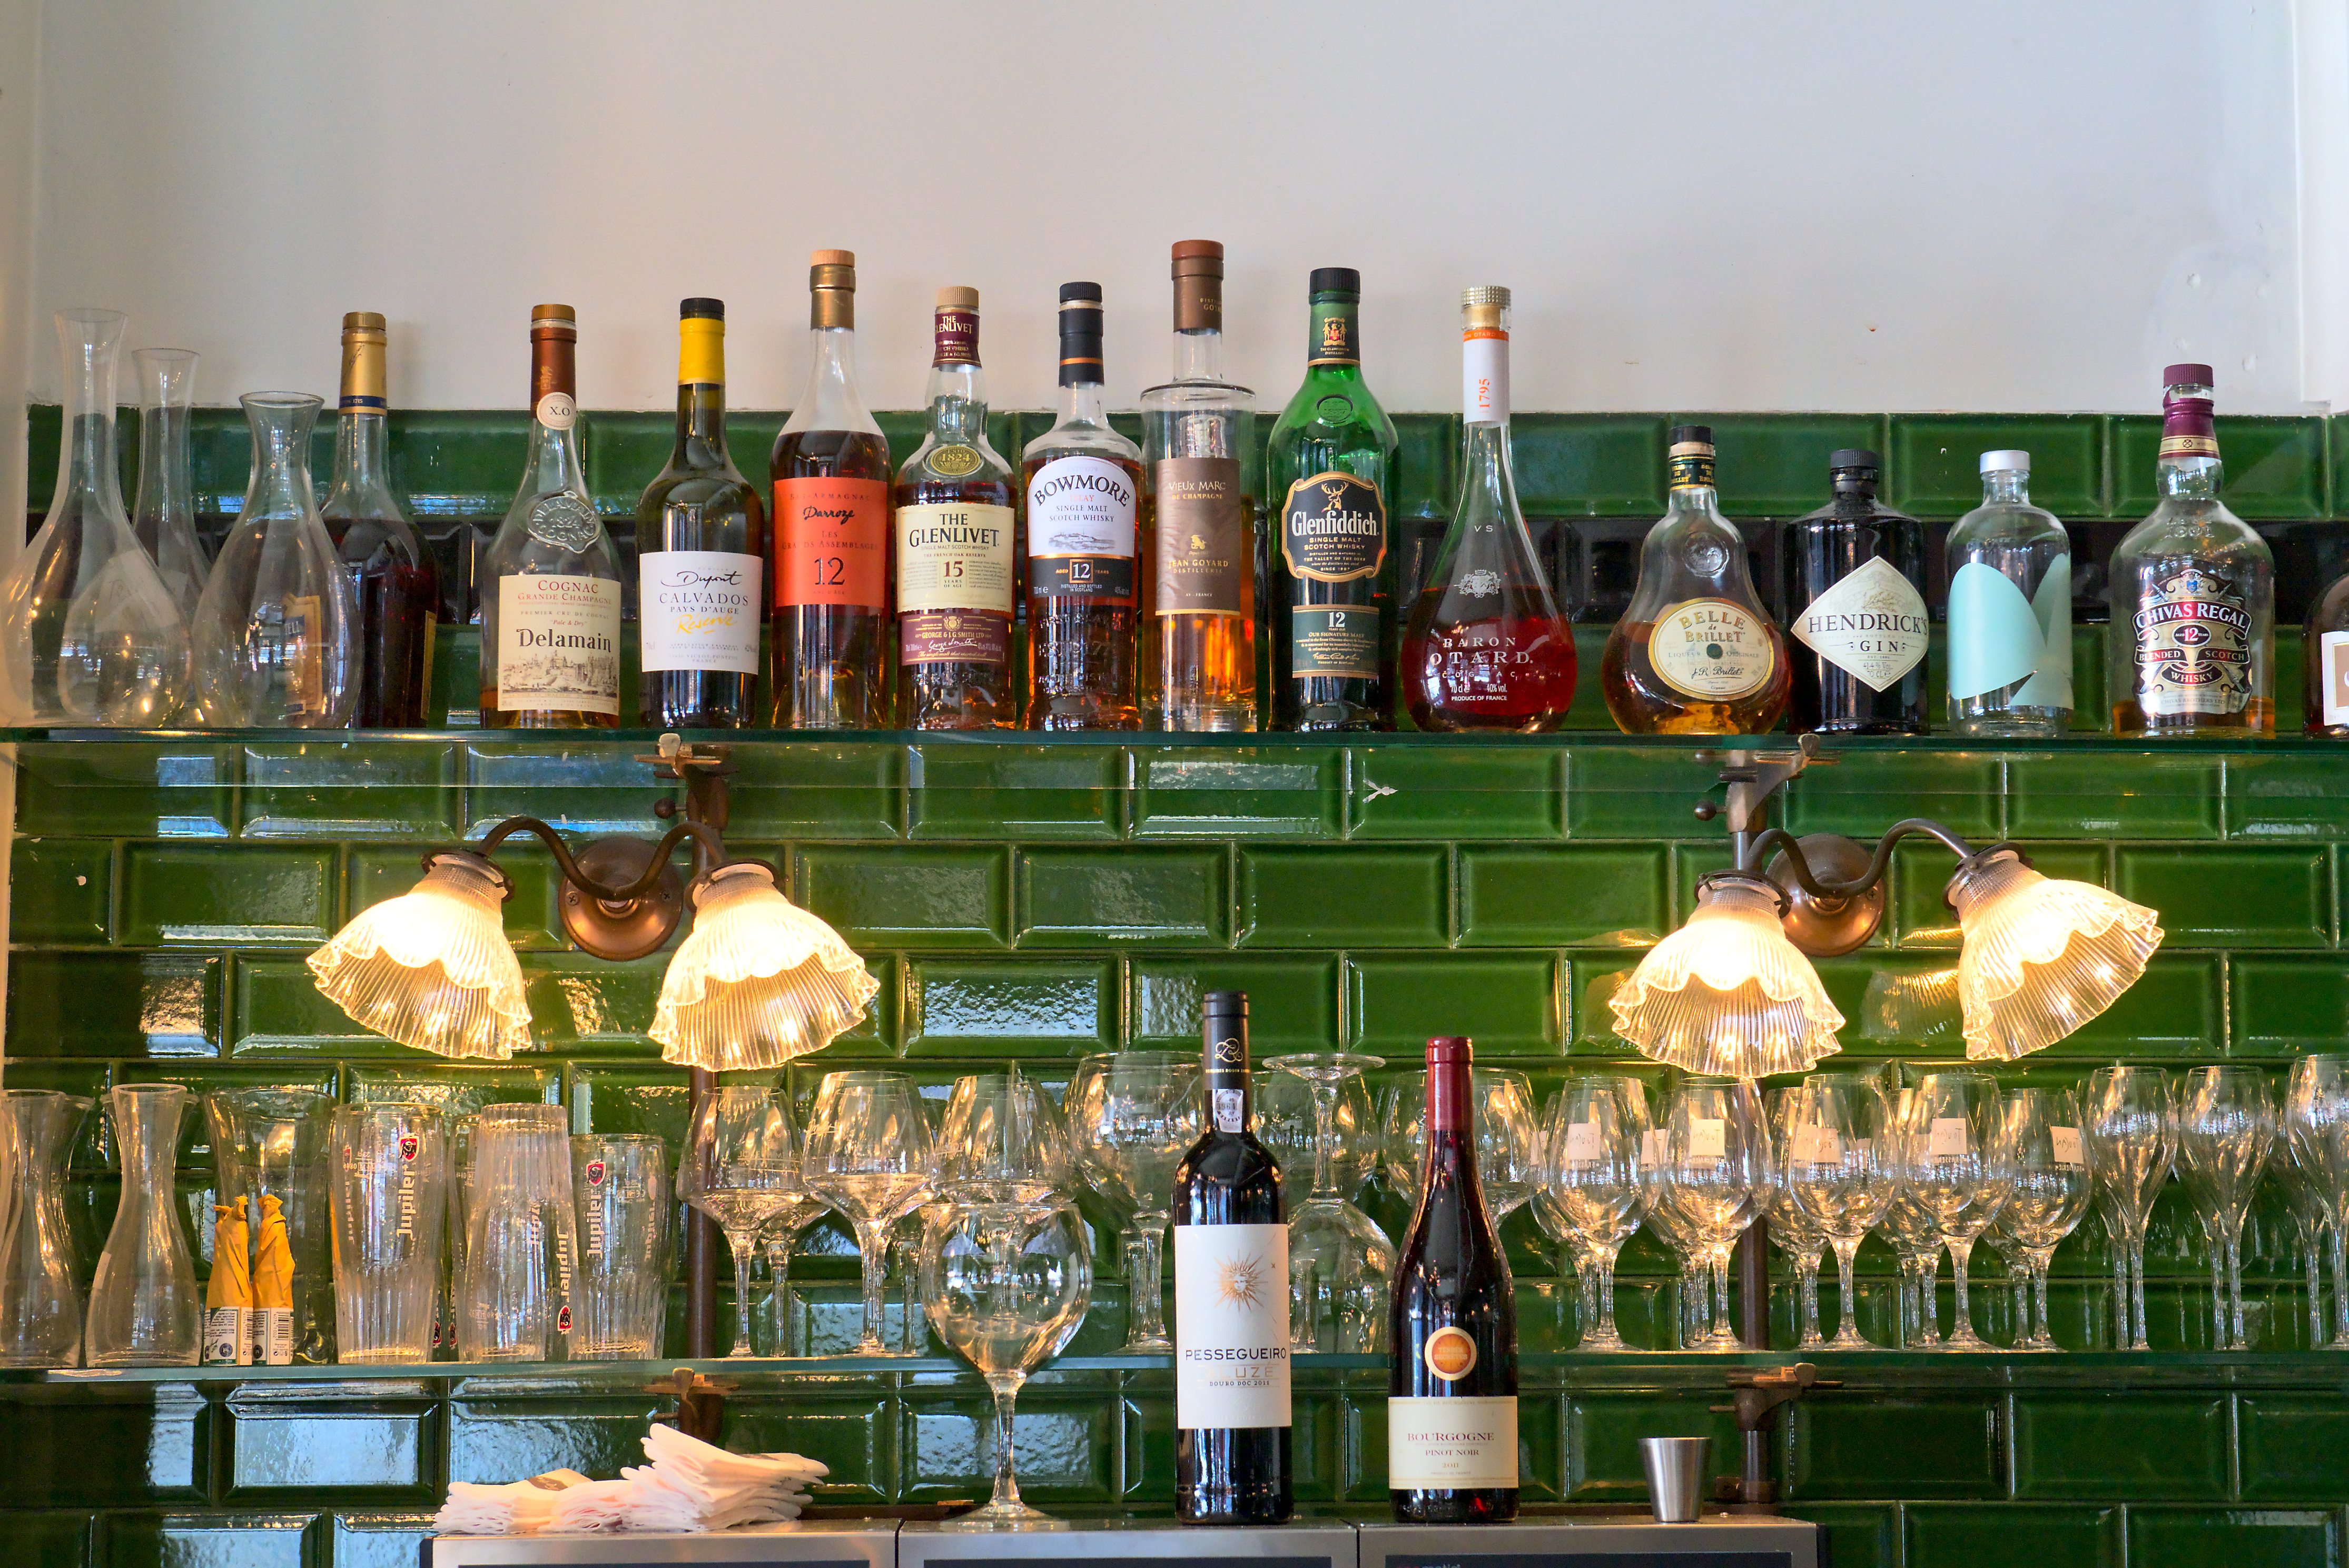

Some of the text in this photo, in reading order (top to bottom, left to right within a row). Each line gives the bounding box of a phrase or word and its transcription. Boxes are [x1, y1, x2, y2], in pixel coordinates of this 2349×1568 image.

[1479, 379, 1490, 409] 1795
[941, 453, 970, 462] 1824
[1034, 475, 1130, 507] BOWMORE
[1168, 481, 1226, 491] VIEUX MARC
[803, 505, 855, 525] Darroze
[940, 513, 968, 525] THE
[1292, 510, 1377, 536] Glenfiddich
[819, 540, 878, 551] ASSEMBLAGES
[814, 557, 845, 585] 12
[943, 561, 963, 577] 15
[1073, 563, 1091, 578] 12
[1169, 560, 1189, 569] JEAN
[538, 580, 599, 593] COGNAC
[661, 571, 742, 589] Dupont
[562, 593, 612, 605] CHAMPAGNE
[659, 593, 748, 606] CALVADOS
[673, 613, 737, 634] Réserve
[1328, 612, 1345, 628] 12
[1679, 611, 1745, 630] BELLE
[2136, 603, 2245, 629] CHIVAS REGAL
[1808, 613, 1928, 636] HENDRICK'S
[516, 629, 611, 653] Delamain
[1685, 631, 1741, 642] BRILLET
[2184, 628, 2198, 641] 12
[1444, 637, 1516, 648] BARON
[1860, 641, 1898, 652] GIN
[2139, 650, 2244, 661] BLENDED SCOTCH
[2171, 671, 2213, 682] WHISKY
[1451, 684, 1457, 693] 70
[1487, 684, 1497, 692] 40%
[397, 1164, 417, 1241] Jupiler
[587, 1188, 605, 1260] Jupiler
[556, 1225, 571, 1303] Jupiler
[1186, 1347, 1287, 1360] PESSEGUEIRO
[1206, 1361, 1274, 1380] ALUZÉ
[1408, 1433, 1495, 1441] BOURGOGNE
